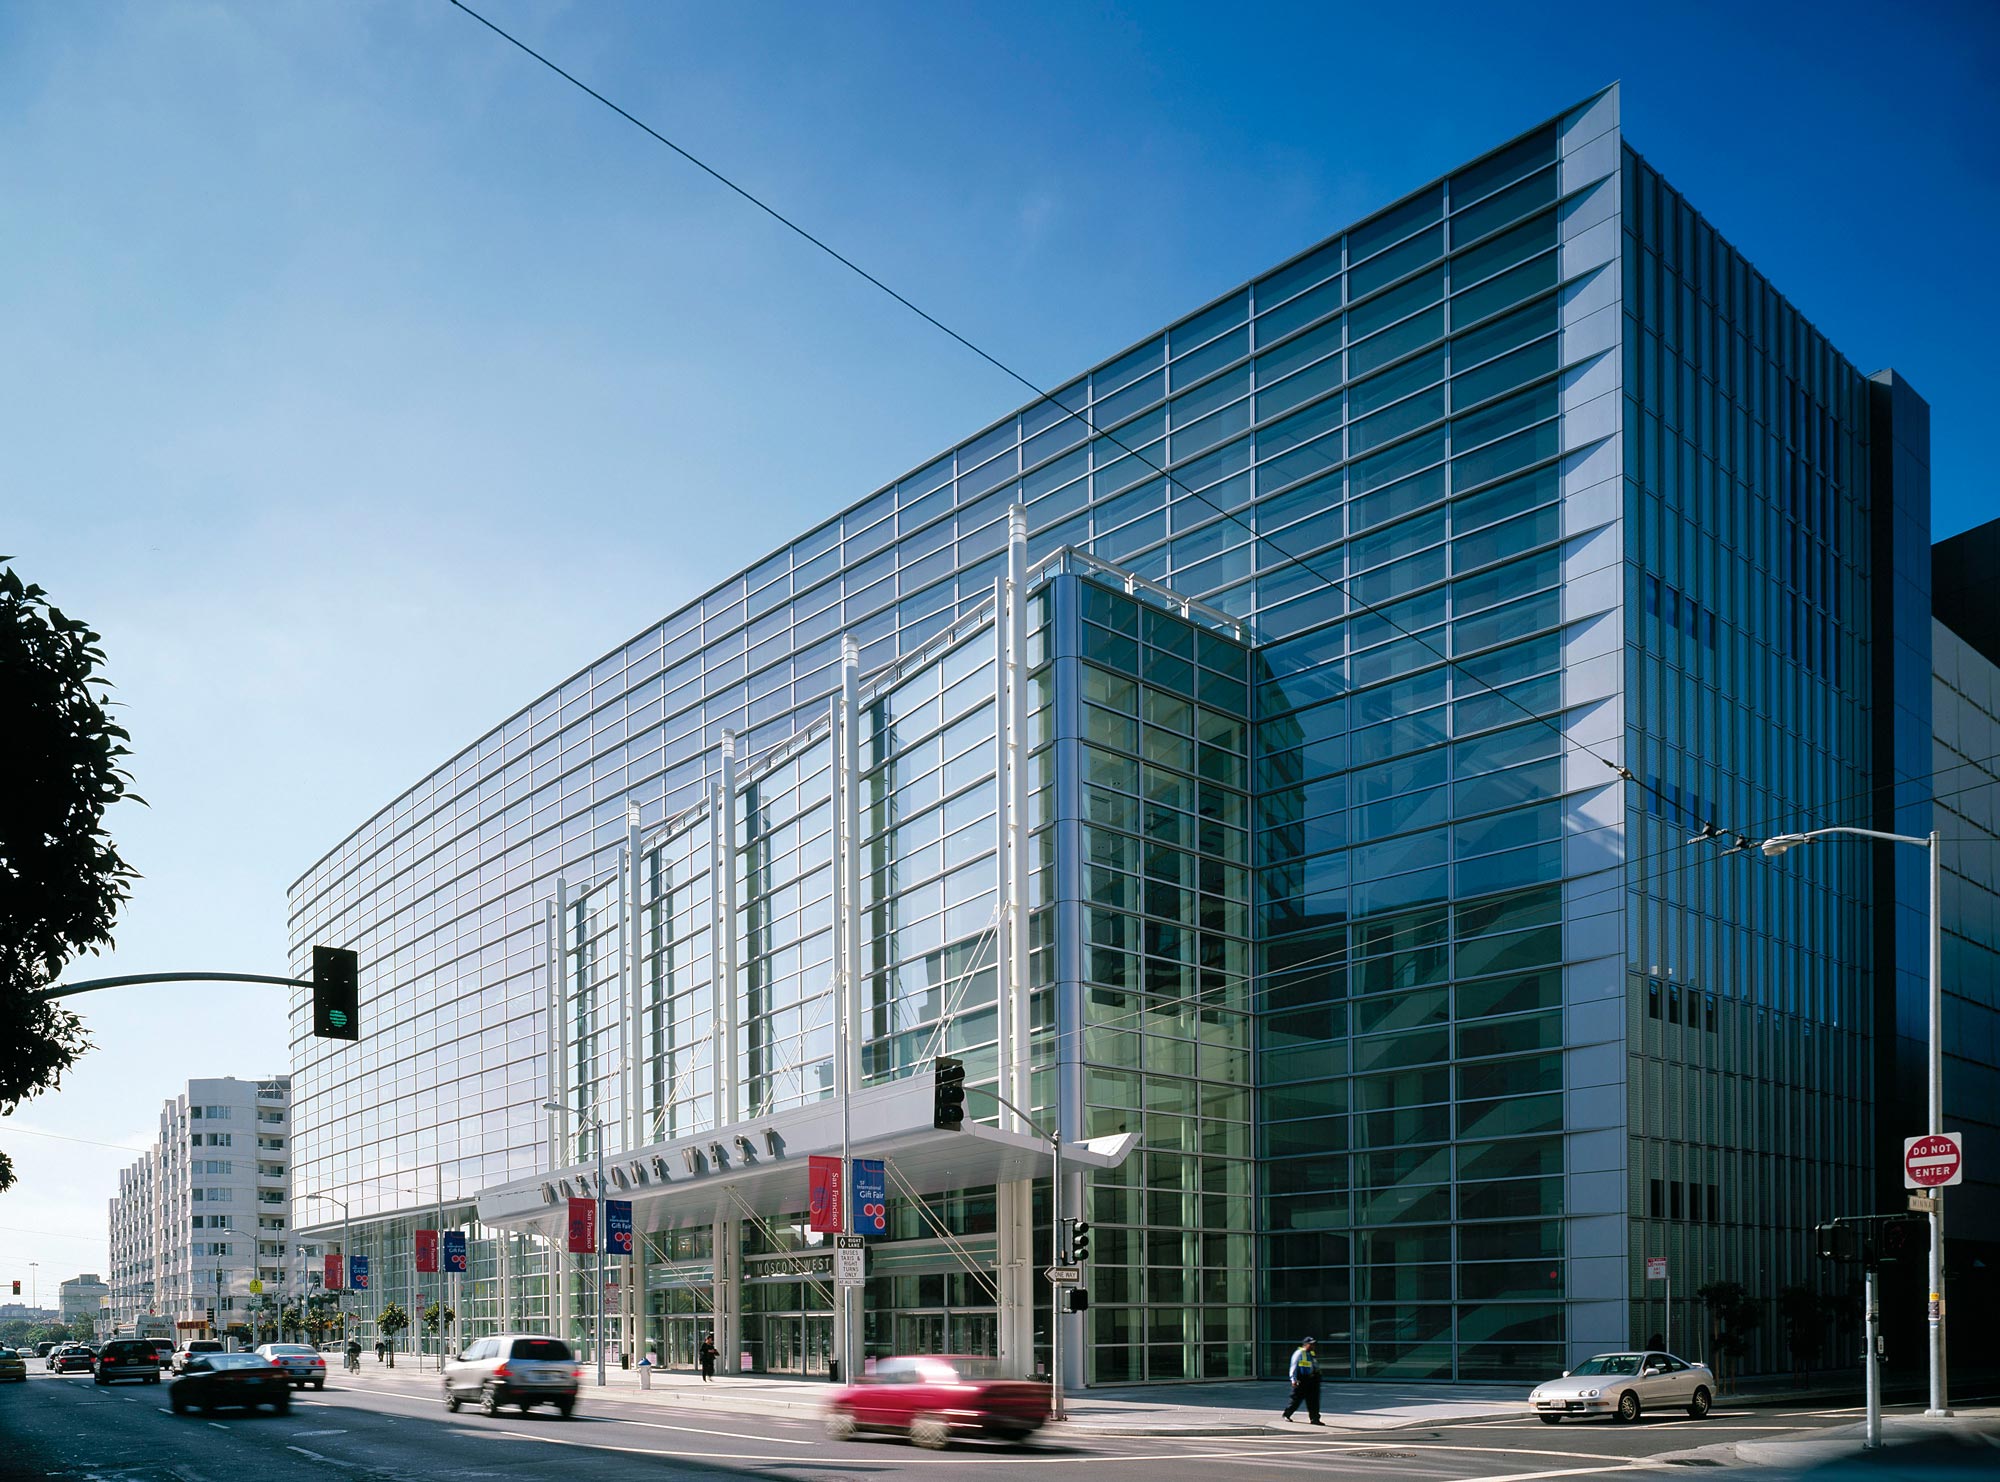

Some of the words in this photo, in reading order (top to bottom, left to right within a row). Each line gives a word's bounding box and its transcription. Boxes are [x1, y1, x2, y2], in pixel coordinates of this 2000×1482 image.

[681, 1127, 773, 1174] WEST
[1913, 1147, 1927, 1155] DO
[1931, 1144, 1952, 1154] NOT
[1915, 1167, 1950, 1177] ENTER
[872, 1191, 884, 1199] Fair
[757, 1261, 800, 1274] MOSCONE
[803, 1258, 830, 1273] WEST
